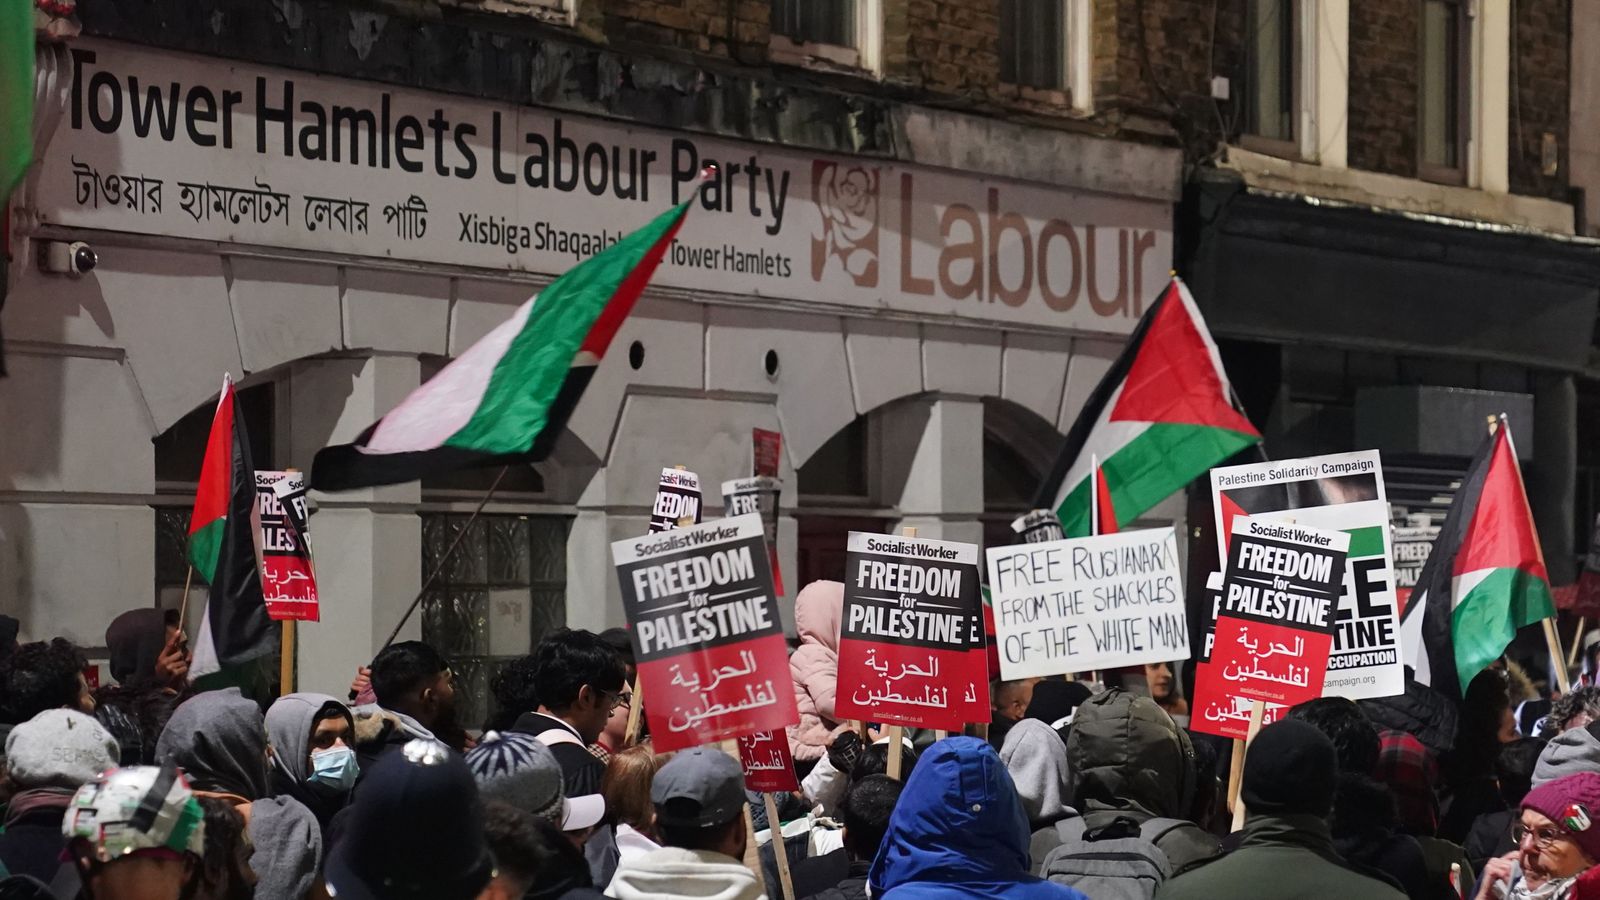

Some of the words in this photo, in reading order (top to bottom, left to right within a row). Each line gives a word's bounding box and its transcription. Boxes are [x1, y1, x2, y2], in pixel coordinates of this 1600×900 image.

[70, 48, 242, 150] Tower
[255, 77, 478, 180] Hamlets
[492, 110, 656, 202] Labour
[671, 138, 790, 236] Party
[304, 196, 369, 235] লেবার
[458, 212, 531, 254] Xisbiga
[669, 237, 721, 269] Tower
[723, 245, 792, 278] Hamlets
[900, 172, 1156, 318] Labour
[1218, 472, 1266, 486] Palestine
[1269, 465, 1318, 480] Solidarity
[1321, 459, 1374, 474] Campaign
[632, 546, 755, 602] FREEDOM
[857, 560, 962, 598] FREEDOM
[996, 549, 1062, 594] FREE
[1072, 540, 1176, 581] RUSHANARA
[1237, 542, 1333, 584] FREEDOM
[1272, 575, 1290, 592] for
[688, 590, 708, 609] for
[899, 593, 917, 609] for
[1000, 597, 1051, 627] FROM
[1051, 590, 1085, 618] THE
[1093, 576, 1176, 612] SHACKLES
[1226, 583, 1331, 627] PALESTINE
[636, 595, 773, 655] PALESTINE
[848, 604, 963, 644] PALESTINE
[1004, 632, 1032, 664] OF
[1038, 625, 1079, 659] THE
[1087, 617, 1143, 654] WHITE
[1149, 612, 1186, 652] MAN
[1236, 626, 1304, 657] الحرية
[669, 650, 757, 693] الحرية
[864, 648, 939, 680] الحرية
[1223, 656, 1309, 687] لفلسطين
[1327, 651, 1395, 670] CCUPATION
[668, 680, 777, 732] لفلسطين
[852, 680, 947, 708] لفلسطين
